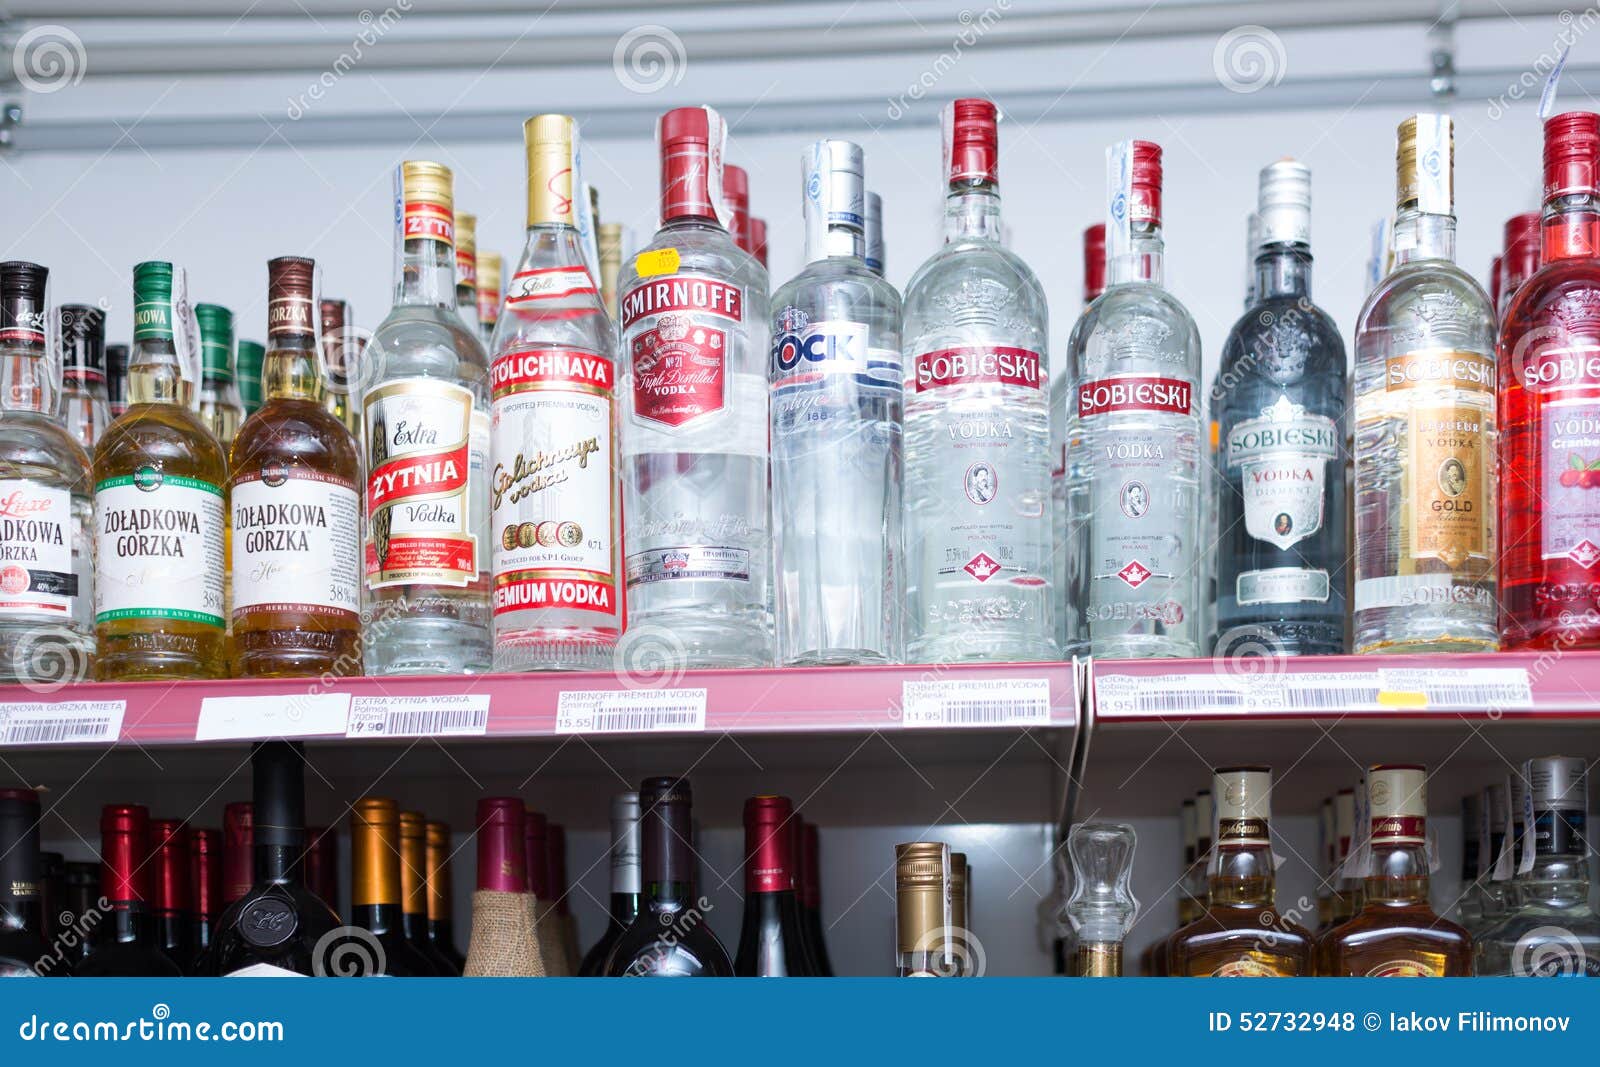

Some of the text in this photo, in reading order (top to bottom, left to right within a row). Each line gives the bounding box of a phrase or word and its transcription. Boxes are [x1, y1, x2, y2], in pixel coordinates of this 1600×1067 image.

[624, 282, 737, 326] SMIRNOFF
[663, 368, 719, 385] Distilled
[918, 353, 1036, 385] SOBIESKI
[1390, 359, 1496, 388] SOBIESKI
[654, 385, 697, 397] VODKA
[1081, 384, 1188, 411] SOBIESKI
[393, 420, 438, 446] Extra
[947, 421, 1014, 440] VODKA
[1231, 429, 1335, 453] SOBIESKI
[1427, 438, 1476, 449] VODKA
[1106, 445, 1164, 459] VODKA
[373, 459, 459, 500] ŻYTNIA
[1252, 468, 1314, 484] VODKA
[405, 503, 456, 524] Vodka
[1431, 500, 1473, 513] GOLD
[104, 507, 200, 535] ŻOŁĄDKOWA
[236, 504, 327, 531] ŻOŁĄDKOWA
[117, 534, 184, 558] GORZKA
[246, 530, 309, 553] GORZKA
[549, 582, 609, 608] VODKA
[958, 681, 1008, 690] PREMIUM
[1011, 681, 1048, 689] VODKA
[1099, 675, 1187, 684] VODKA PREMIUM
[355, 697, 387, 705] EXTRA
[431, 695, 470, 704] WODKA
[561, 690, 705, 701] SMIRNOFF PREMIUM VODKA
[561, 701, 603, 709] Smirnoff
[47, 703, 87, 712] GORZKA
